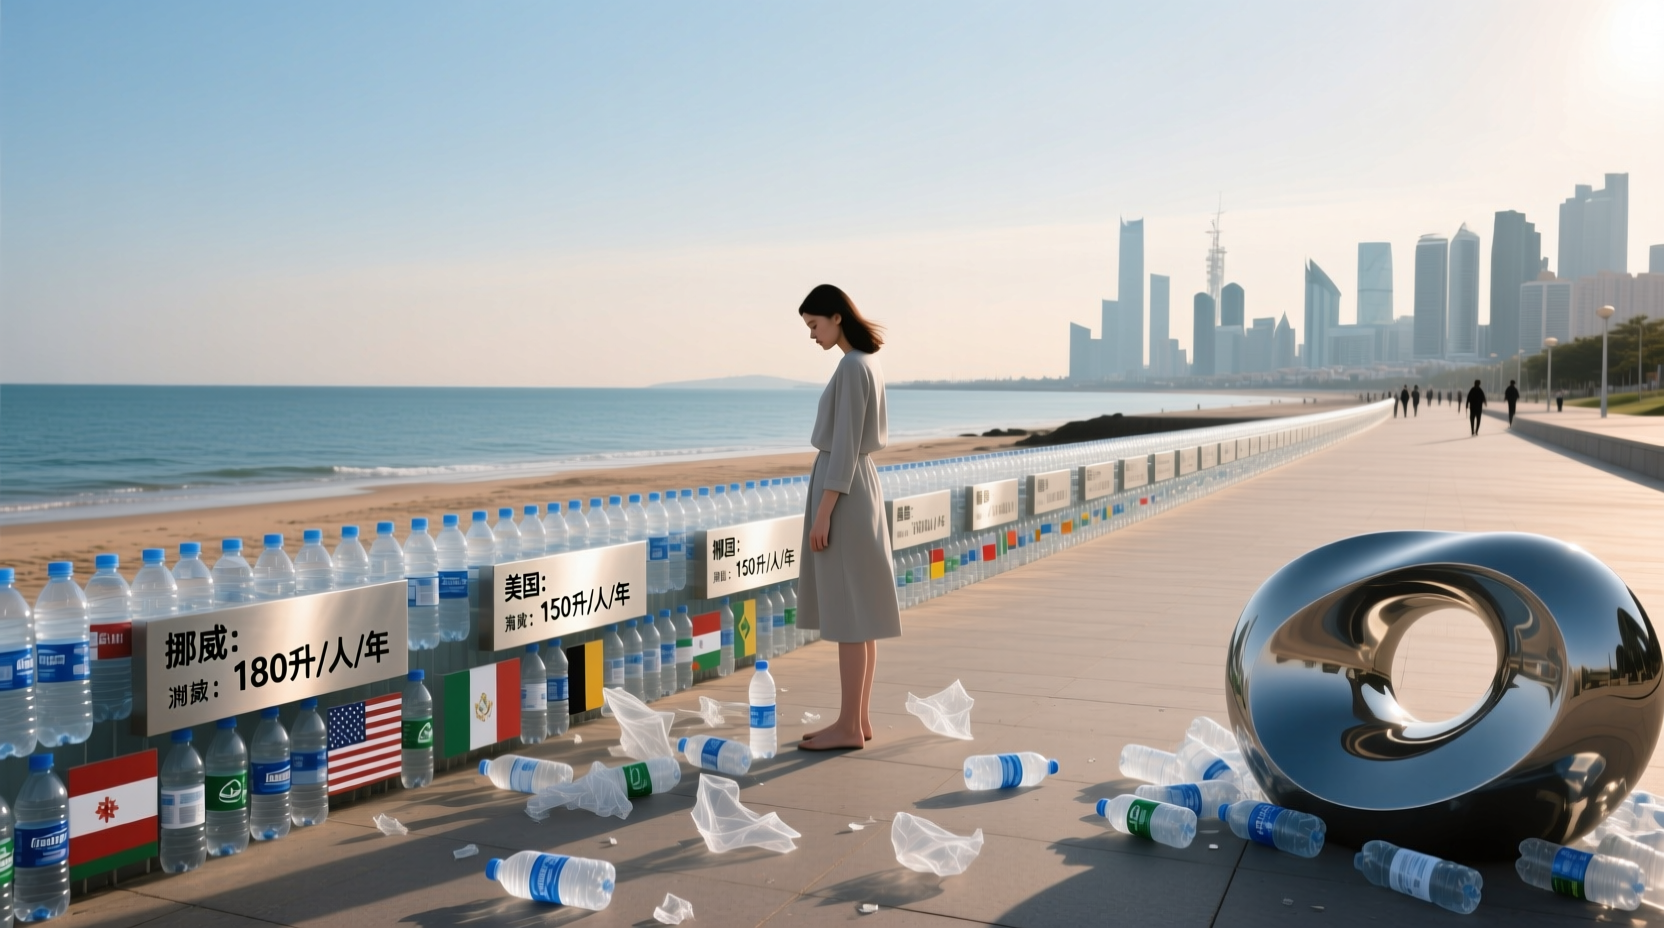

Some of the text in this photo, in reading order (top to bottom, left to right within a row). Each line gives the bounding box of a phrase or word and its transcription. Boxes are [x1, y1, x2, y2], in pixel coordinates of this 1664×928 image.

[504, 571, 546, 603] 美国：
[540, 581, 631, 623] 150升/人/年
[164, 623, 239, 670] 挪威：
[233, 630, 390, 691] 180升/人/年
